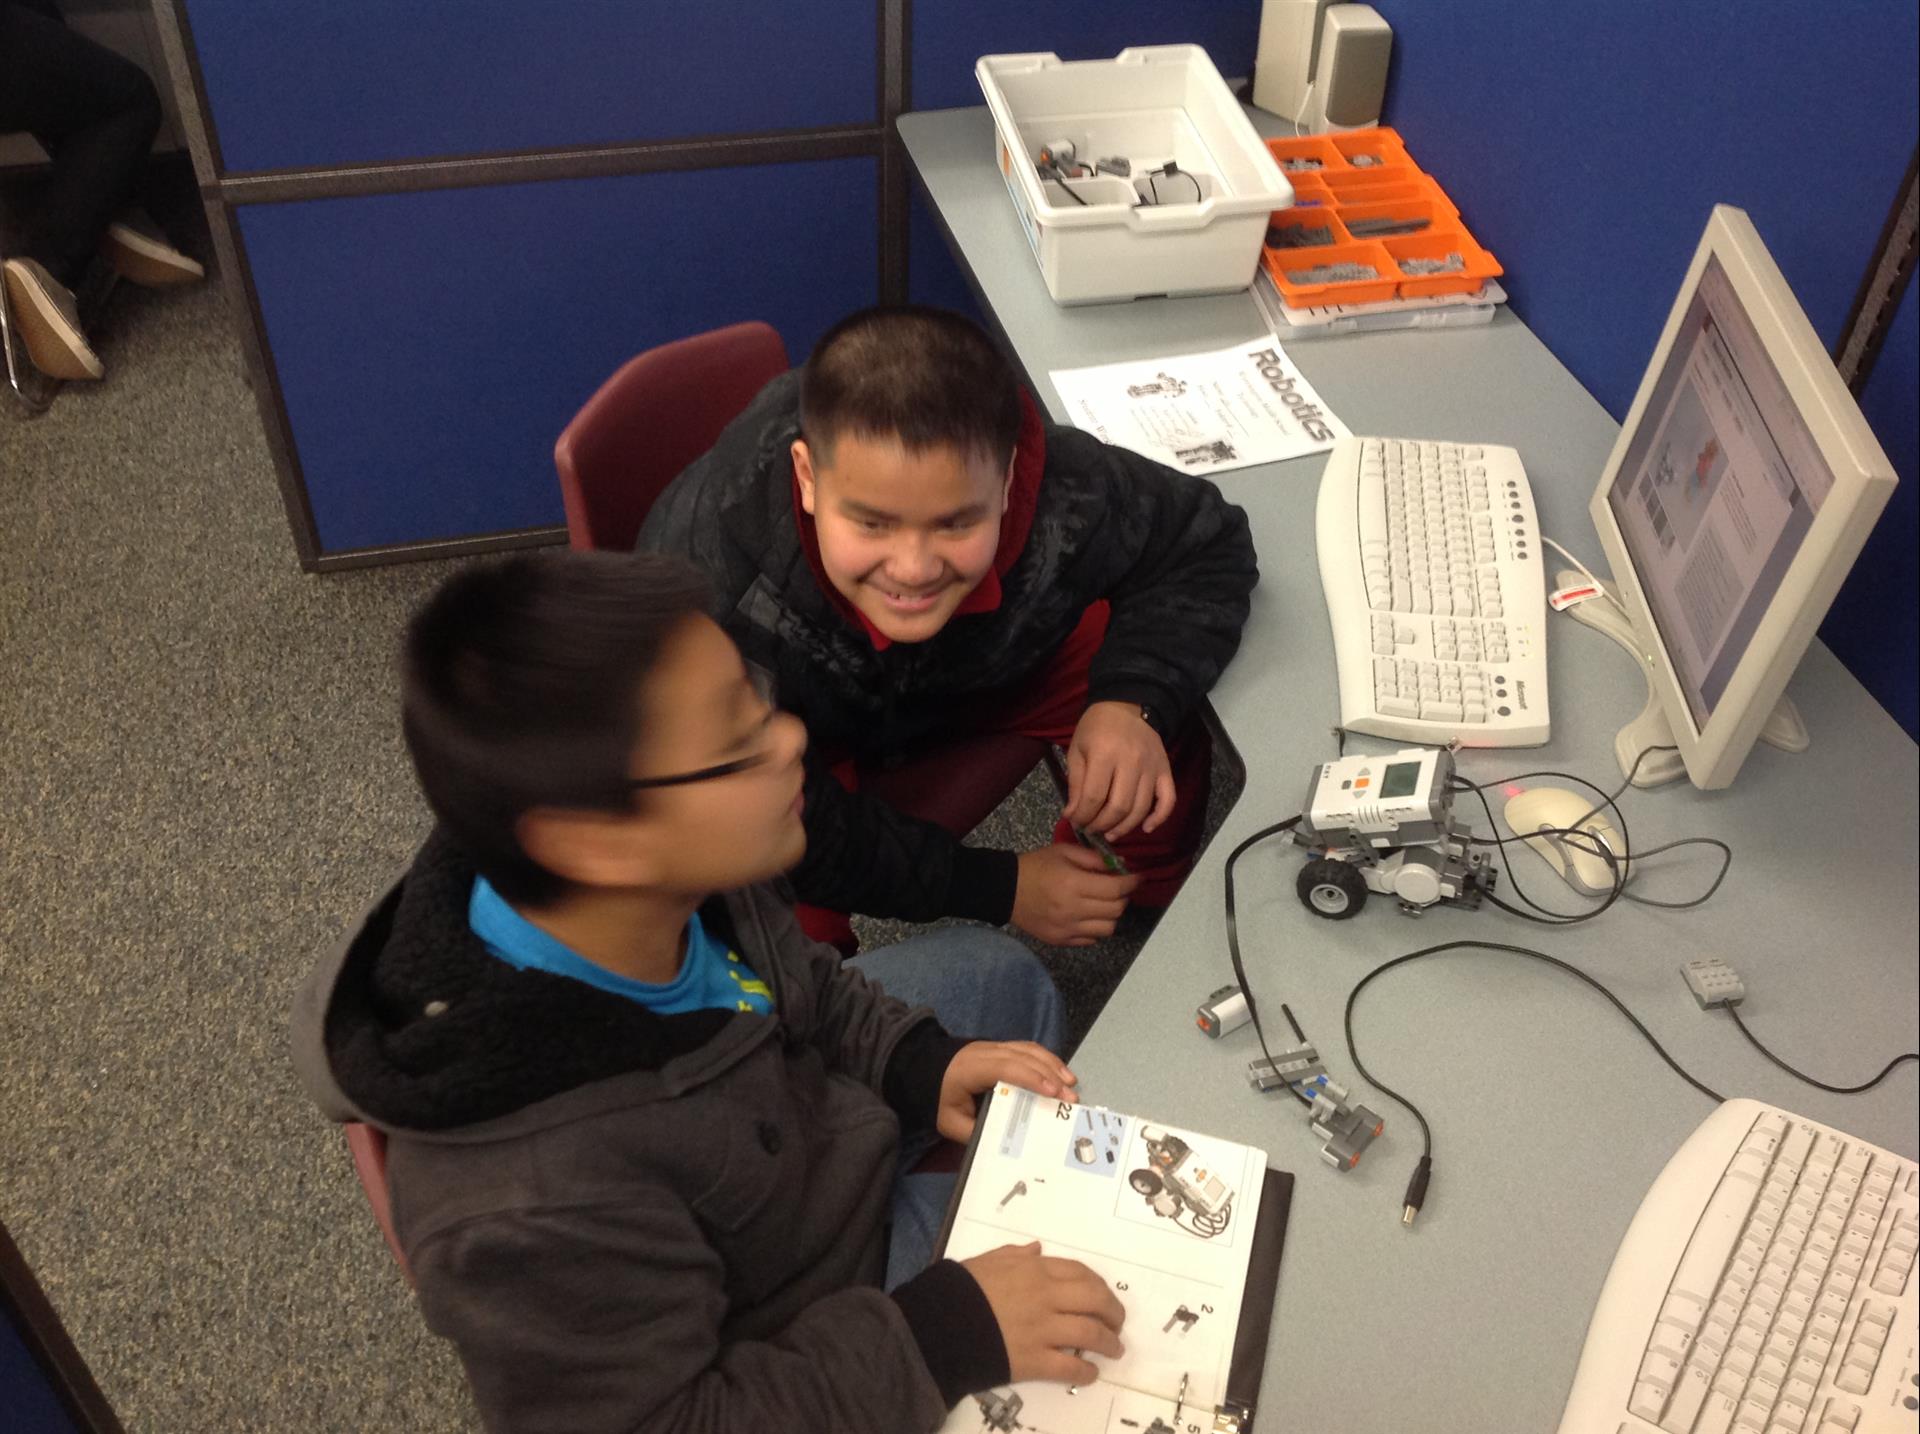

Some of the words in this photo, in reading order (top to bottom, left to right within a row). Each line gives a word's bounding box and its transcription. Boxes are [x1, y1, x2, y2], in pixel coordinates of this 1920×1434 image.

[1248, 347, 1336, 443] Robotics
[1056, 1101, 1073, 1121] 22
[1116, 1281, 1129, 1291] 3
[1201, 1303, 1214, 1314] 2
[1187, 1424, 1200, 1434] 5
